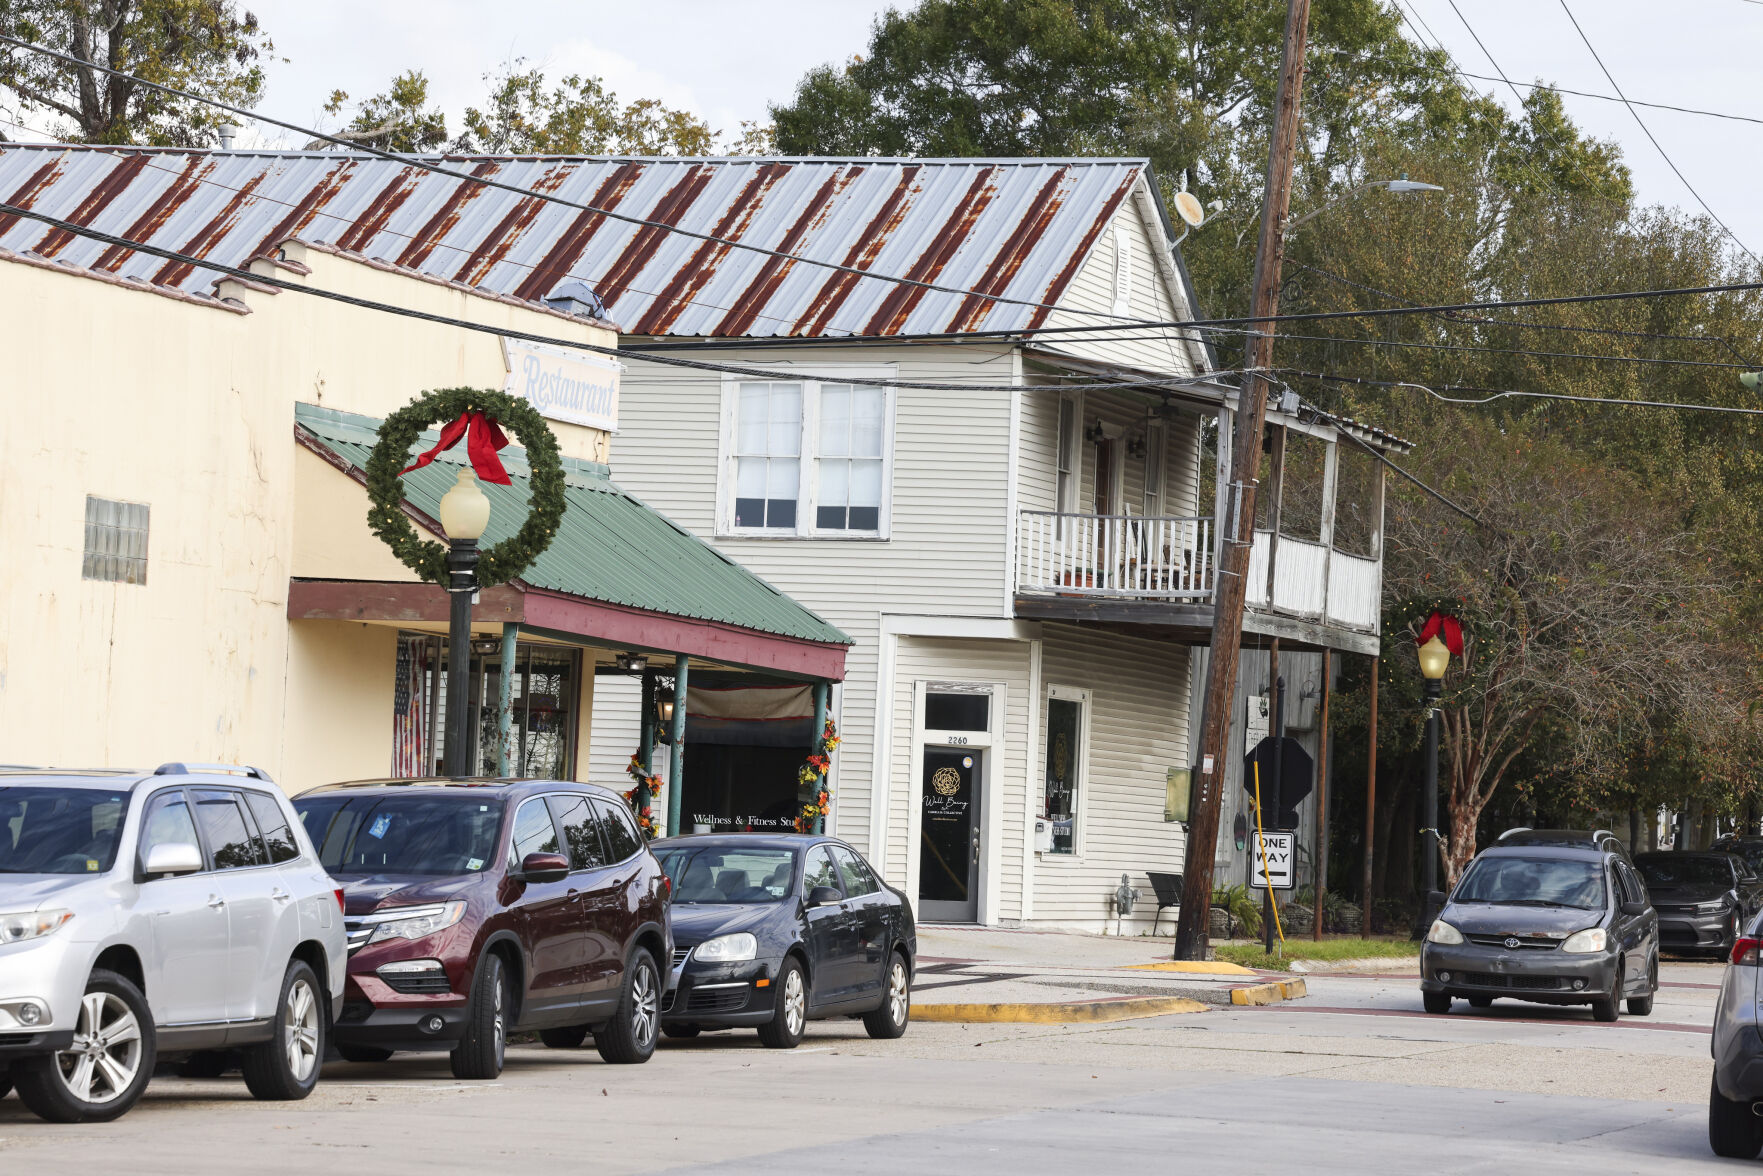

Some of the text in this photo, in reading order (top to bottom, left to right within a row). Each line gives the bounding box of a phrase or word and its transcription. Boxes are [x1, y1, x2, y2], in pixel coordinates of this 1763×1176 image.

[523, 354, 615, 417] Restaurant
[948, 736, 968, 745] 2260
[693, 814, 796, 827] Wellness & Fitness Stu
[1259, 838, 1287, 849] ONE
[1256, 852, 1289, 863] WAY
